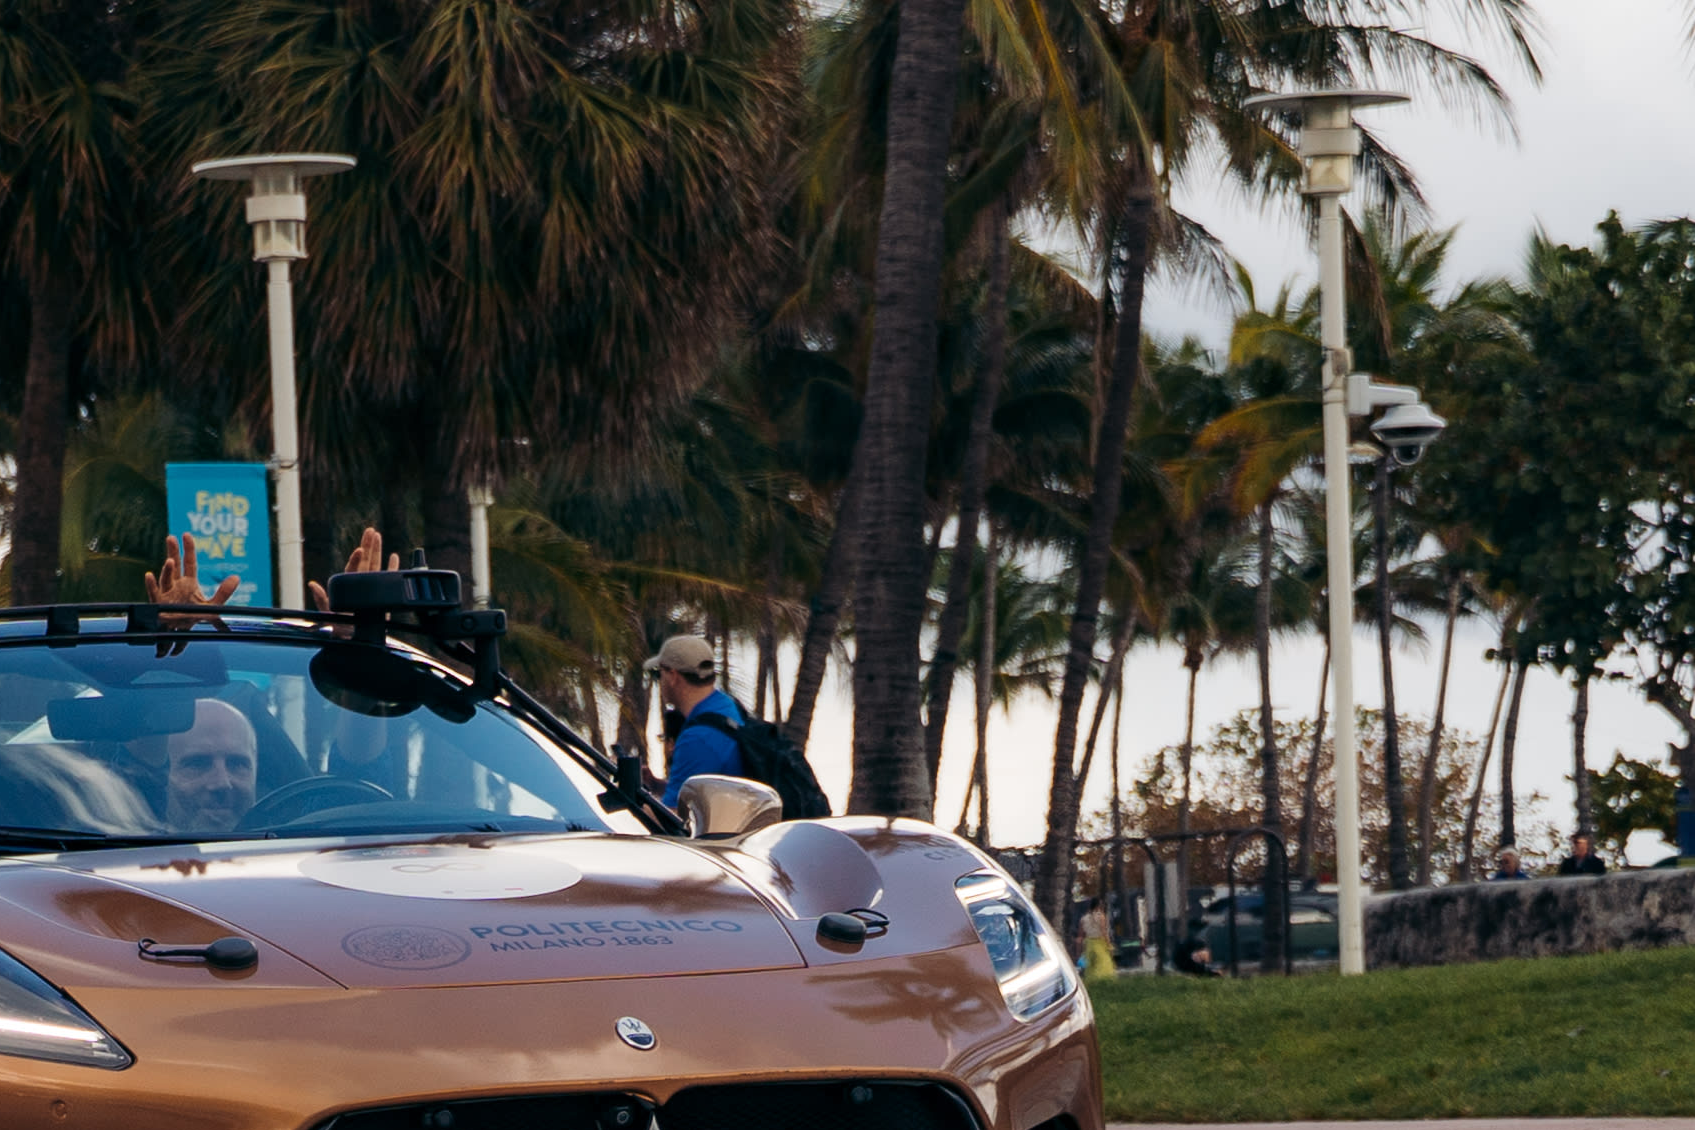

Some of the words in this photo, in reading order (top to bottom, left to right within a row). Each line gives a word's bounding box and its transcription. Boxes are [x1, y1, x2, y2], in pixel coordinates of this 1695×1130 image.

[196, 491, 249, 516] FIND
[187, 510, 249, 537] YOUR
[194, 534, 245, 558] WAVE
[469, 919, 744, 939] POLITECNICO
[489, 936, 605, 952] MILANO
[611, 935, 674, 947] 1863
